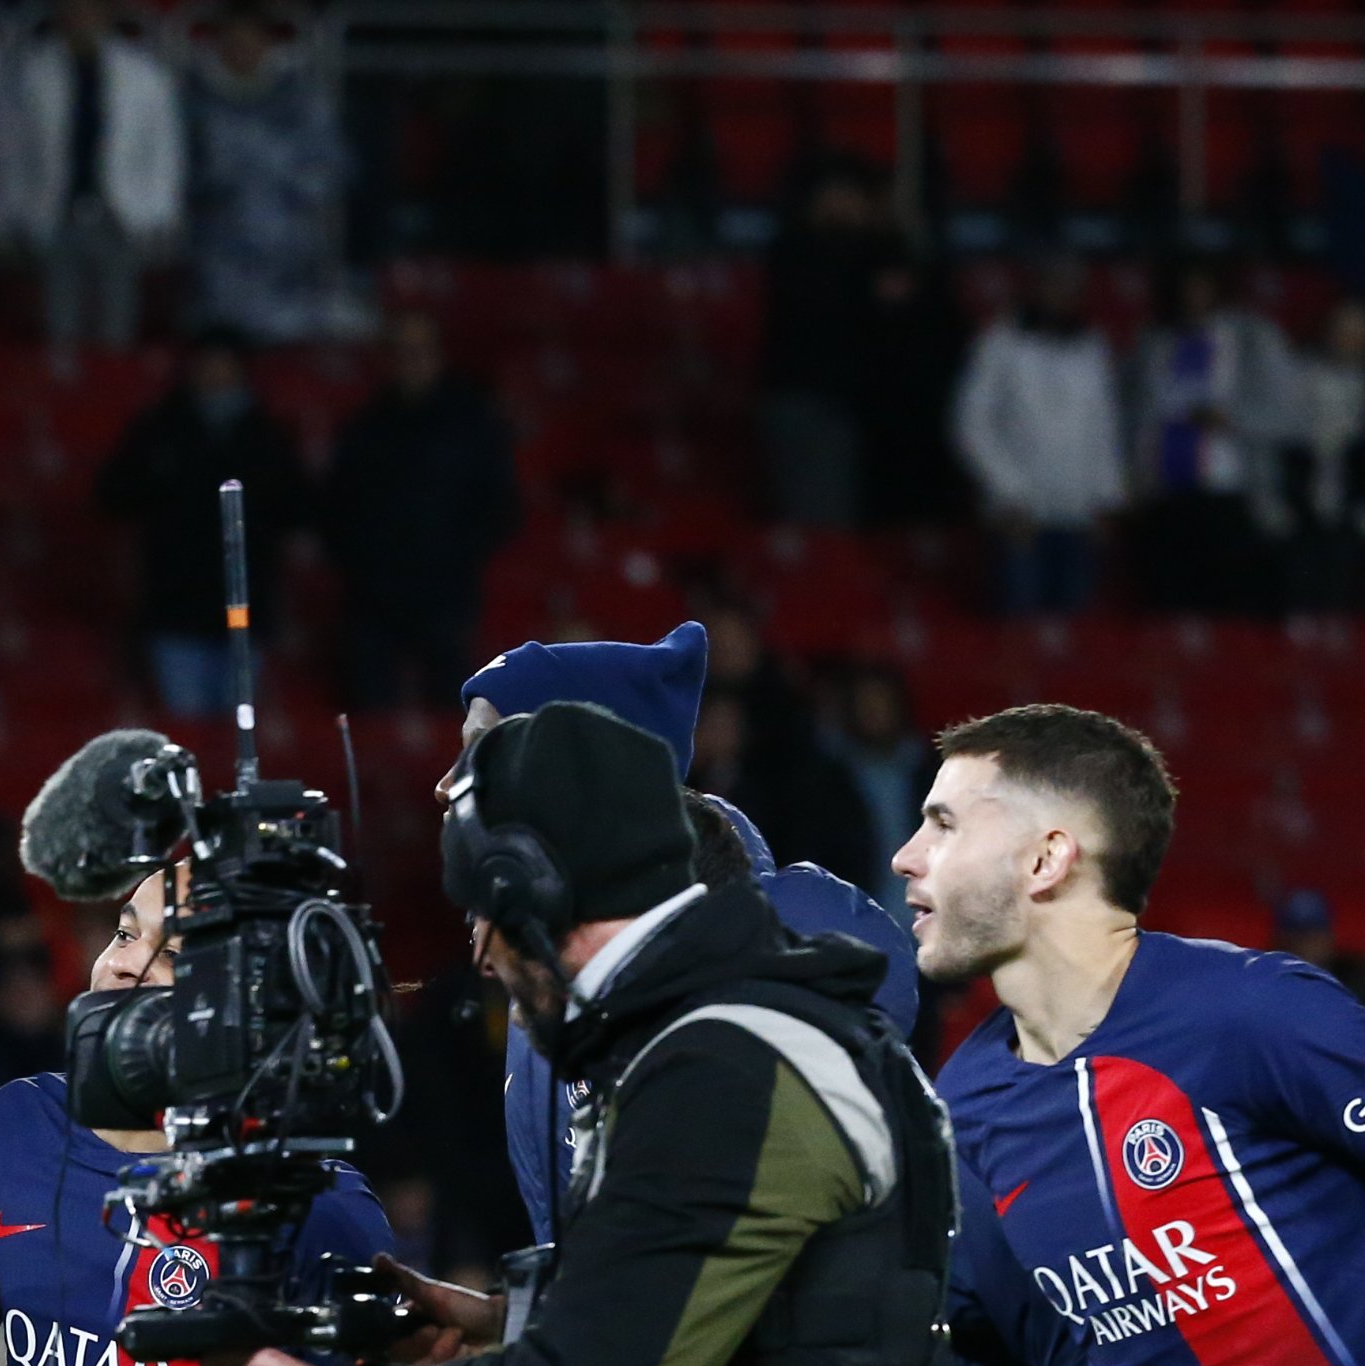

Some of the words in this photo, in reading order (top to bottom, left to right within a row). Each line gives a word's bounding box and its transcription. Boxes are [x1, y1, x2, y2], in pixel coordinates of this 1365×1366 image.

[1128, 1123, 1164, 1145] PARIS
[1033, 1219, 1217, 1325] QATAR
[1089, 1265, 1238, 1345] AIRWAYS
